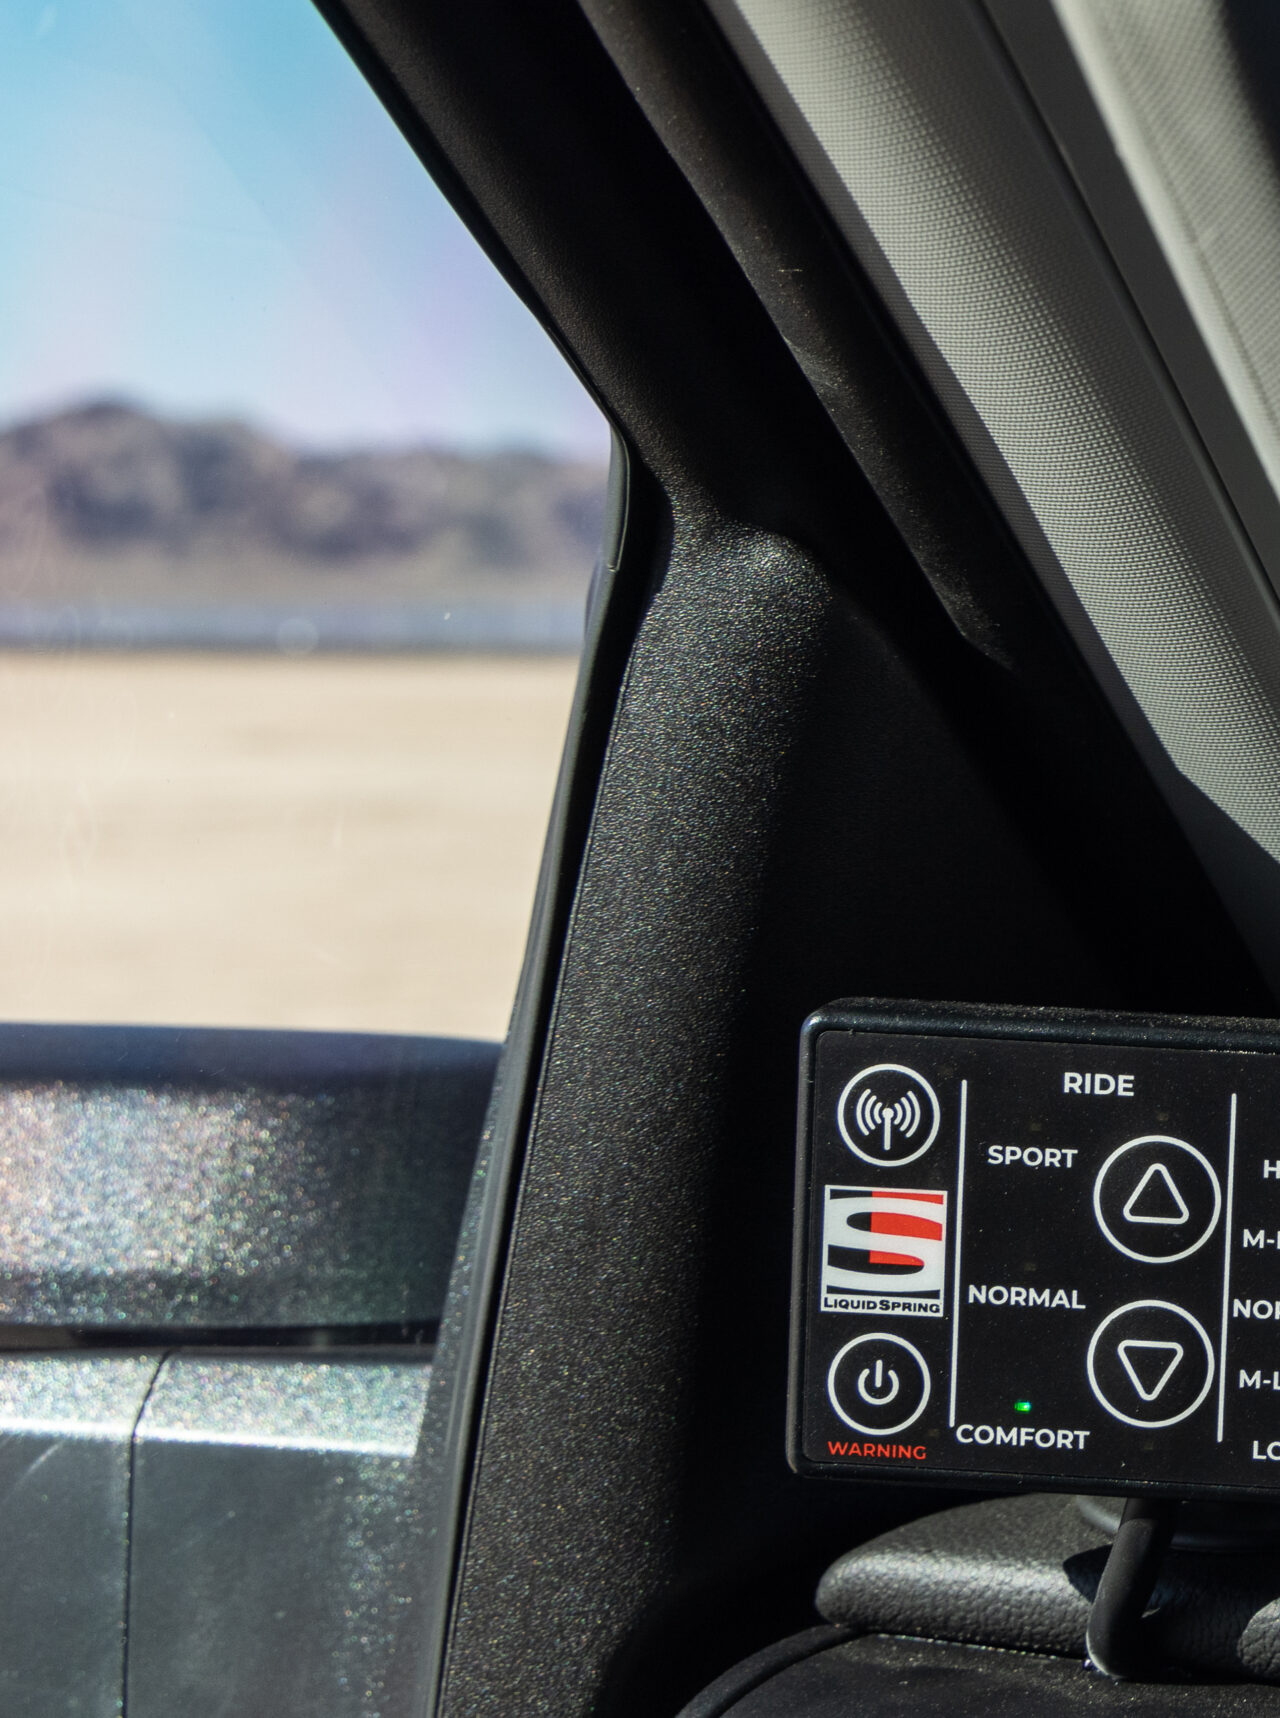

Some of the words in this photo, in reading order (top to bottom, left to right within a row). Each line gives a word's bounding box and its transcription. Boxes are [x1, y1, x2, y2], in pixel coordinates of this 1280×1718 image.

[1063, 1071, 1135, 1097] RIDE
[987, 1144, 1078, 1168] SPORT
[967, 1284, 1086, 1310] NORMAL
[955, 1423, 1091, 1450] COMFORT
[827, 1440, 927, 1460] WARNING
